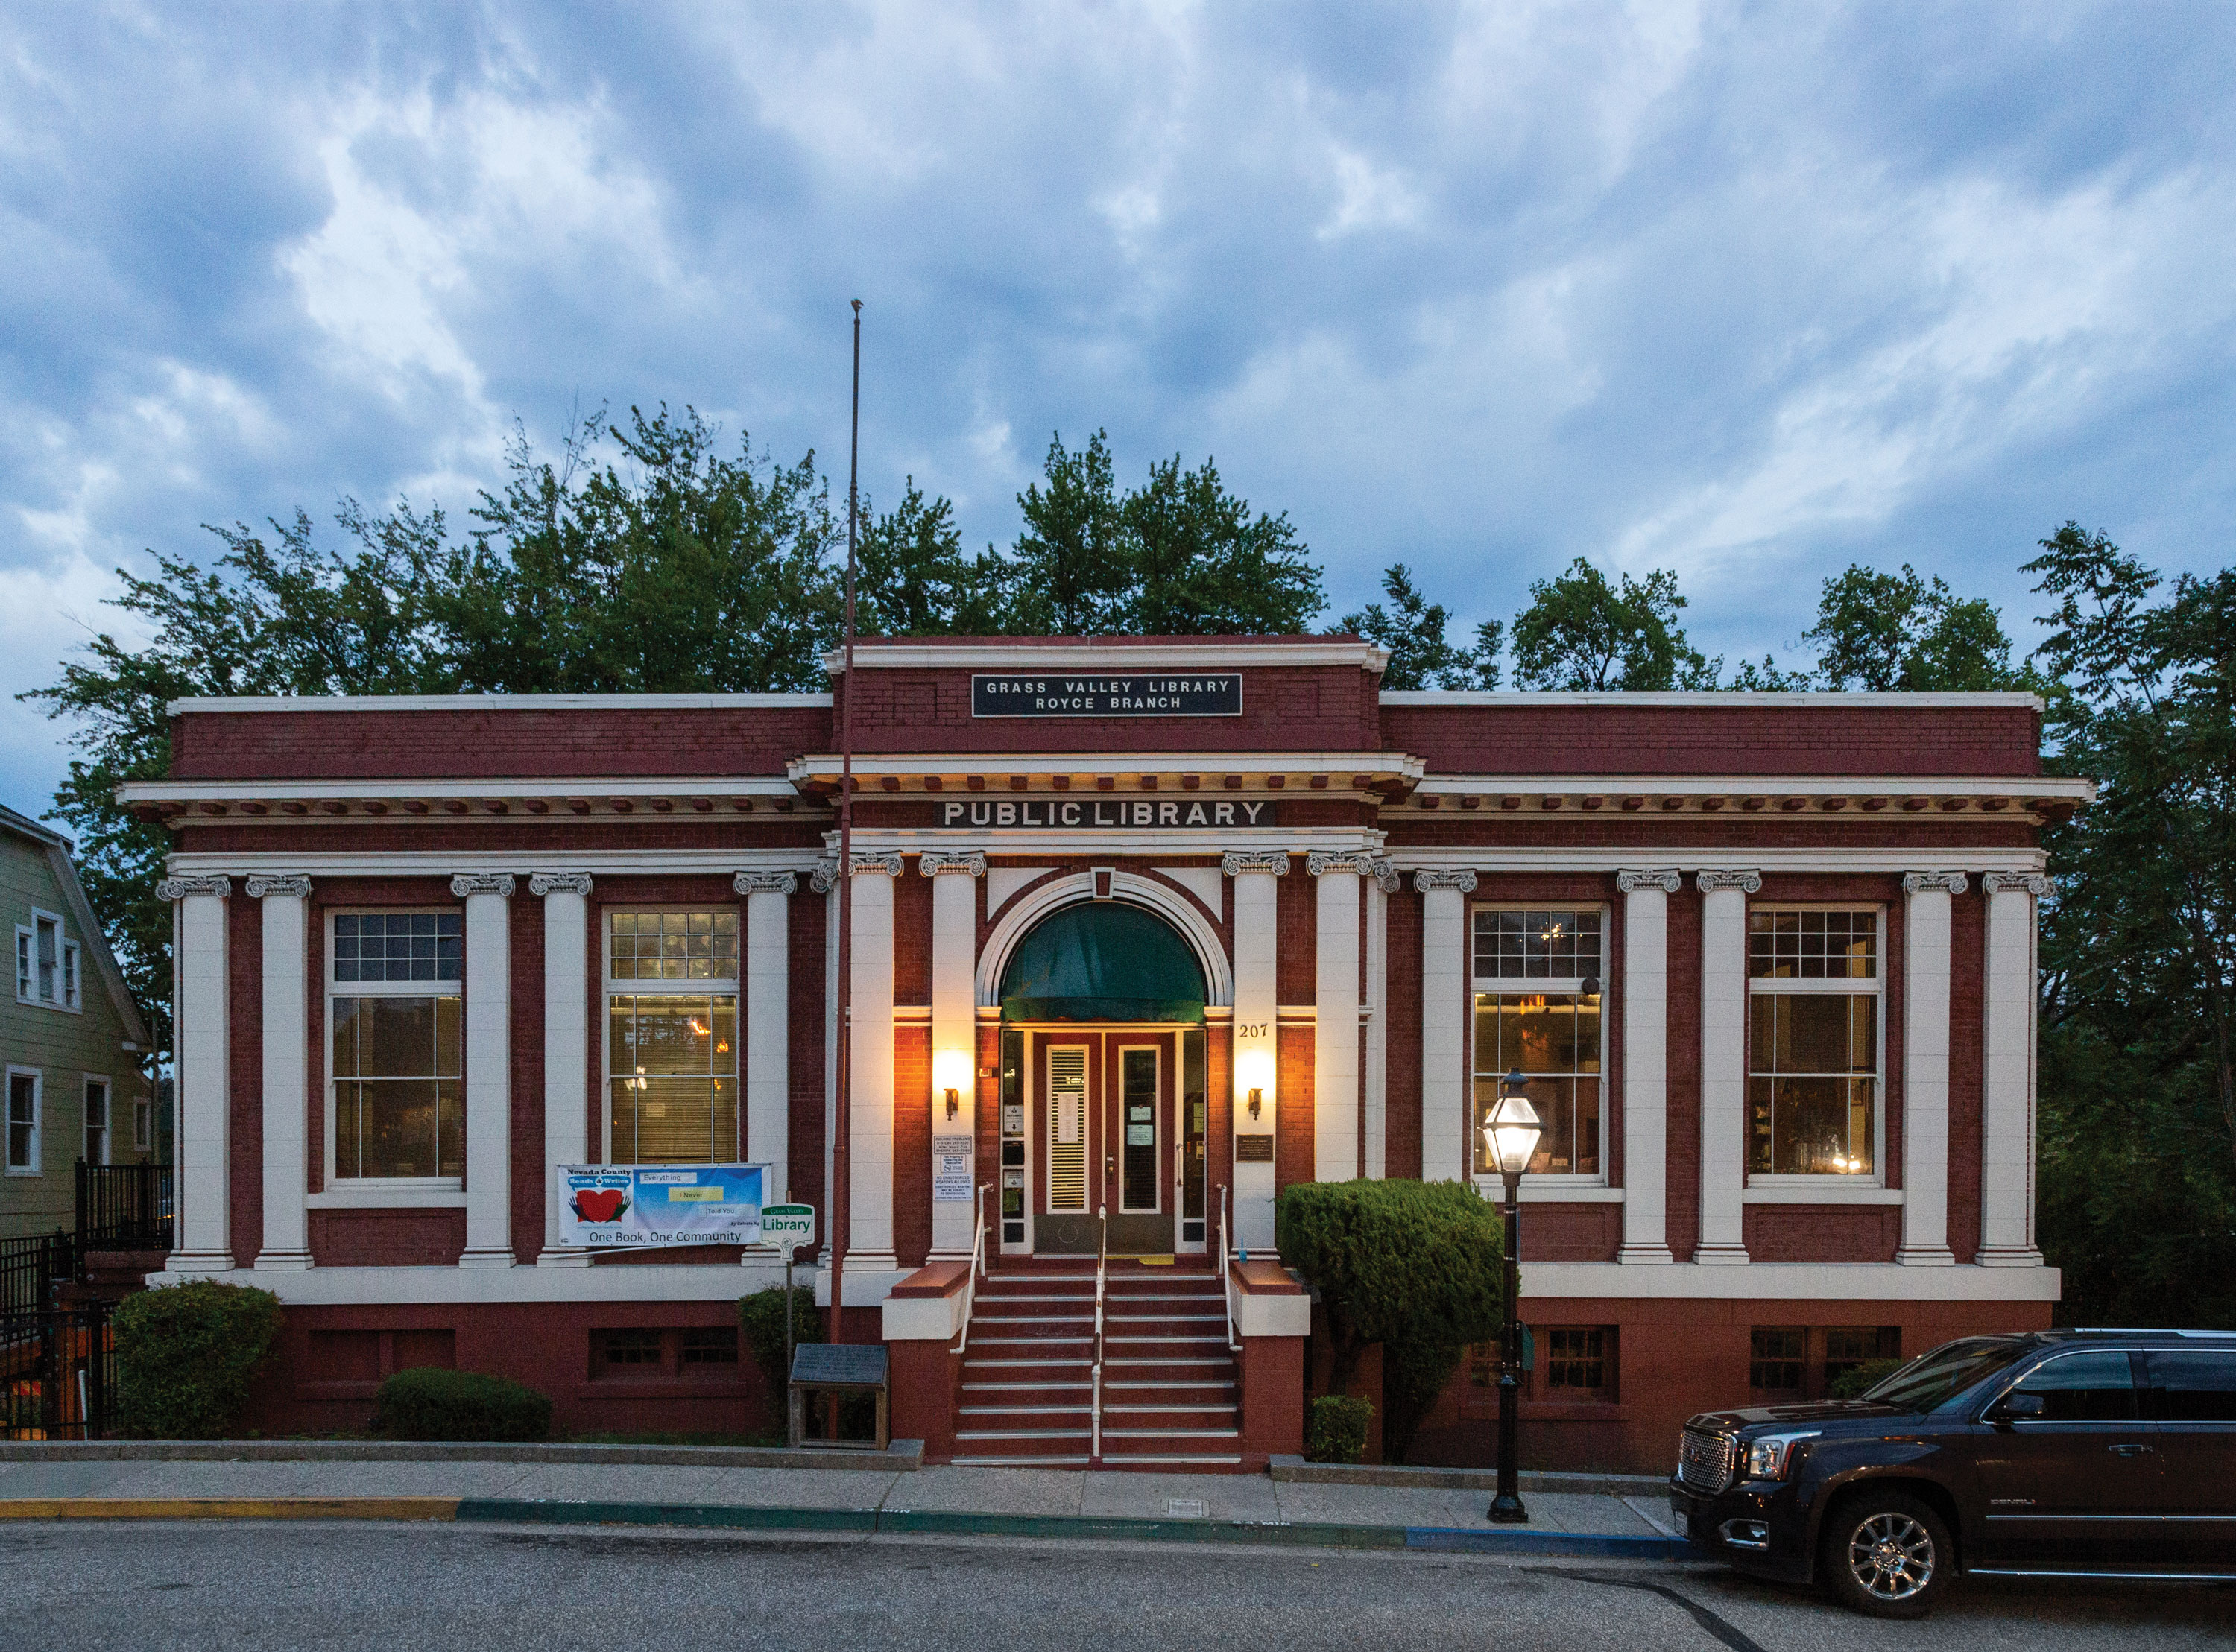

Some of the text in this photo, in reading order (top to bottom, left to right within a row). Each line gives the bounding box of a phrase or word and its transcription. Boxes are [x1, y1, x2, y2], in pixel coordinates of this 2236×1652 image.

[986, 681, 1228, 693] GRASS VALLEY LIBRARY
[1036, 697, 1180, 709] ROYCE BRANCH
[944, 802, 1265, 826] PUBLIC LIBRARY
[1239, 1023, 1268, 1037] 207
[763, 1218, 810, 1233] Library
[590, 1230, 741, 1244] One Book, One Community
